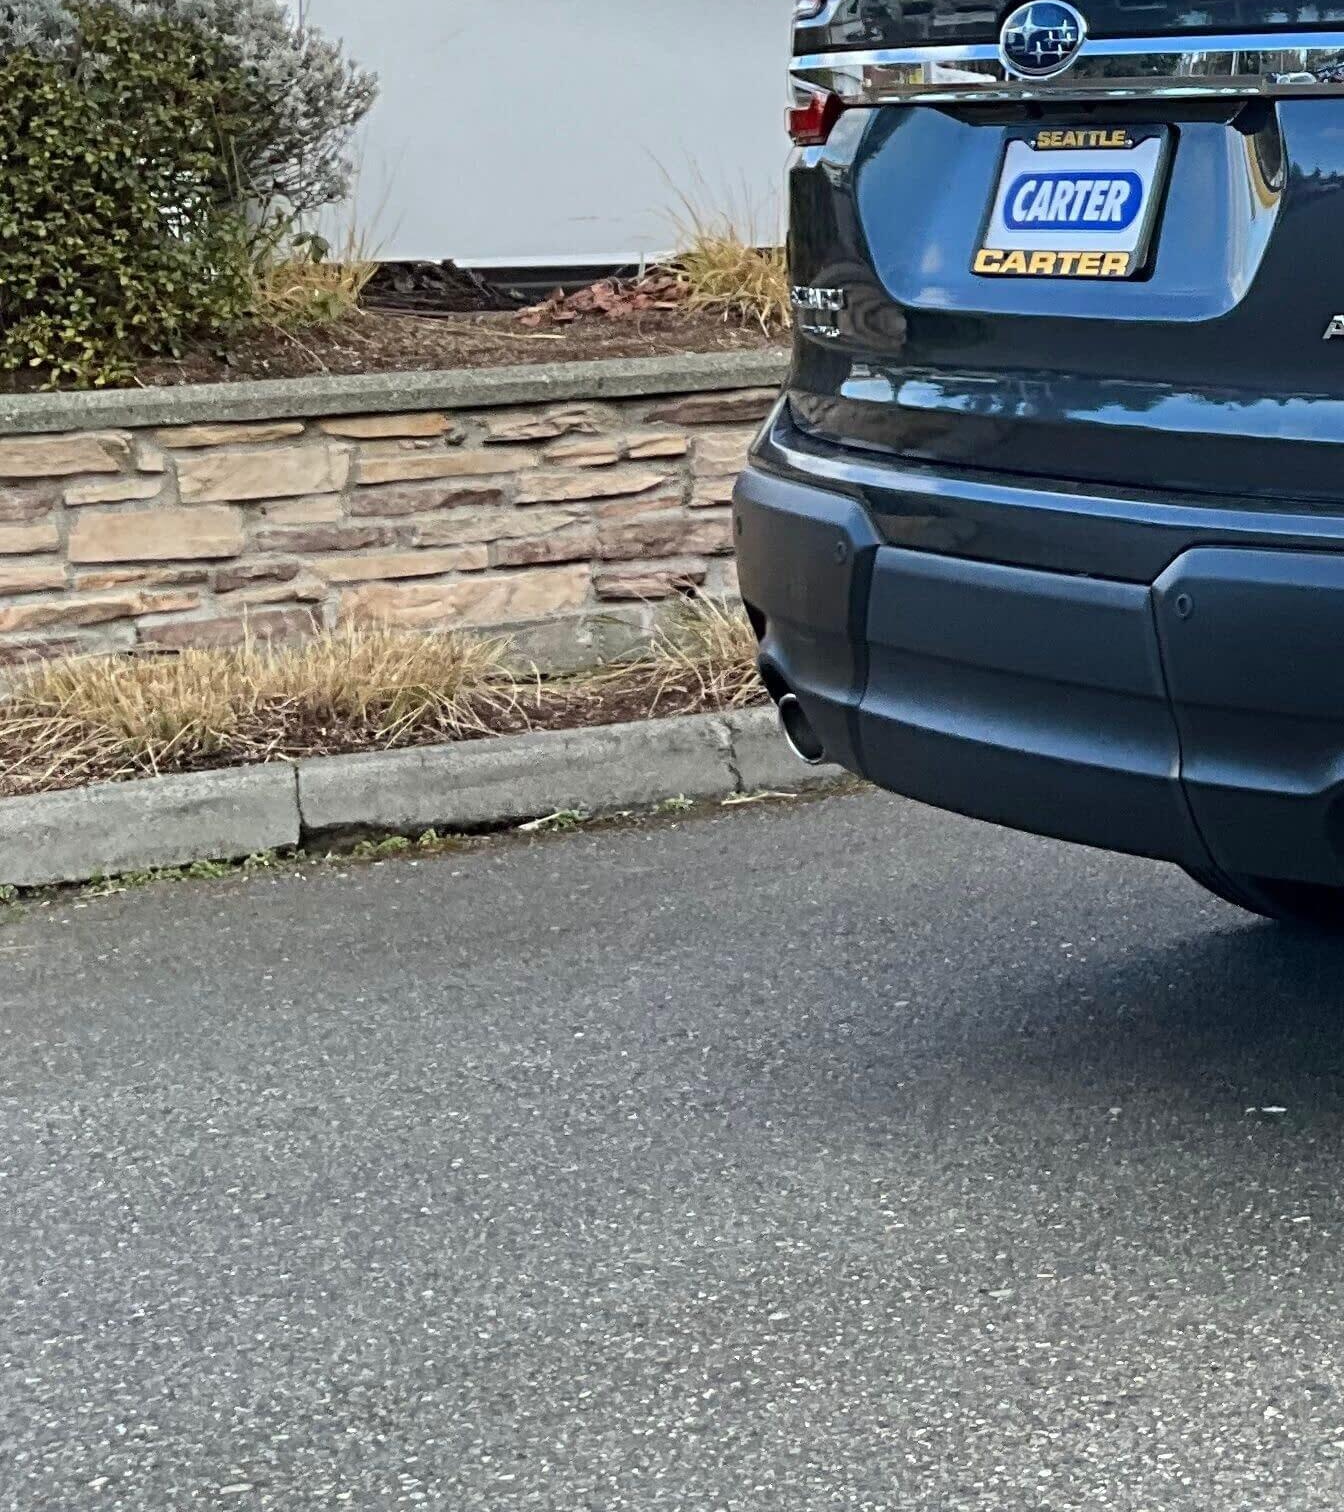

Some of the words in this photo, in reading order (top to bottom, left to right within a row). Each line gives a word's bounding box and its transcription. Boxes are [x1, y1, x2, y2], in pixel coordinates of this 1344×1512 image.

[1037, 130, 1126, 148] SEATTLE
[1012, 179, 1131, 222] CARTER
[973, 249, 1130, 276] CARTER
